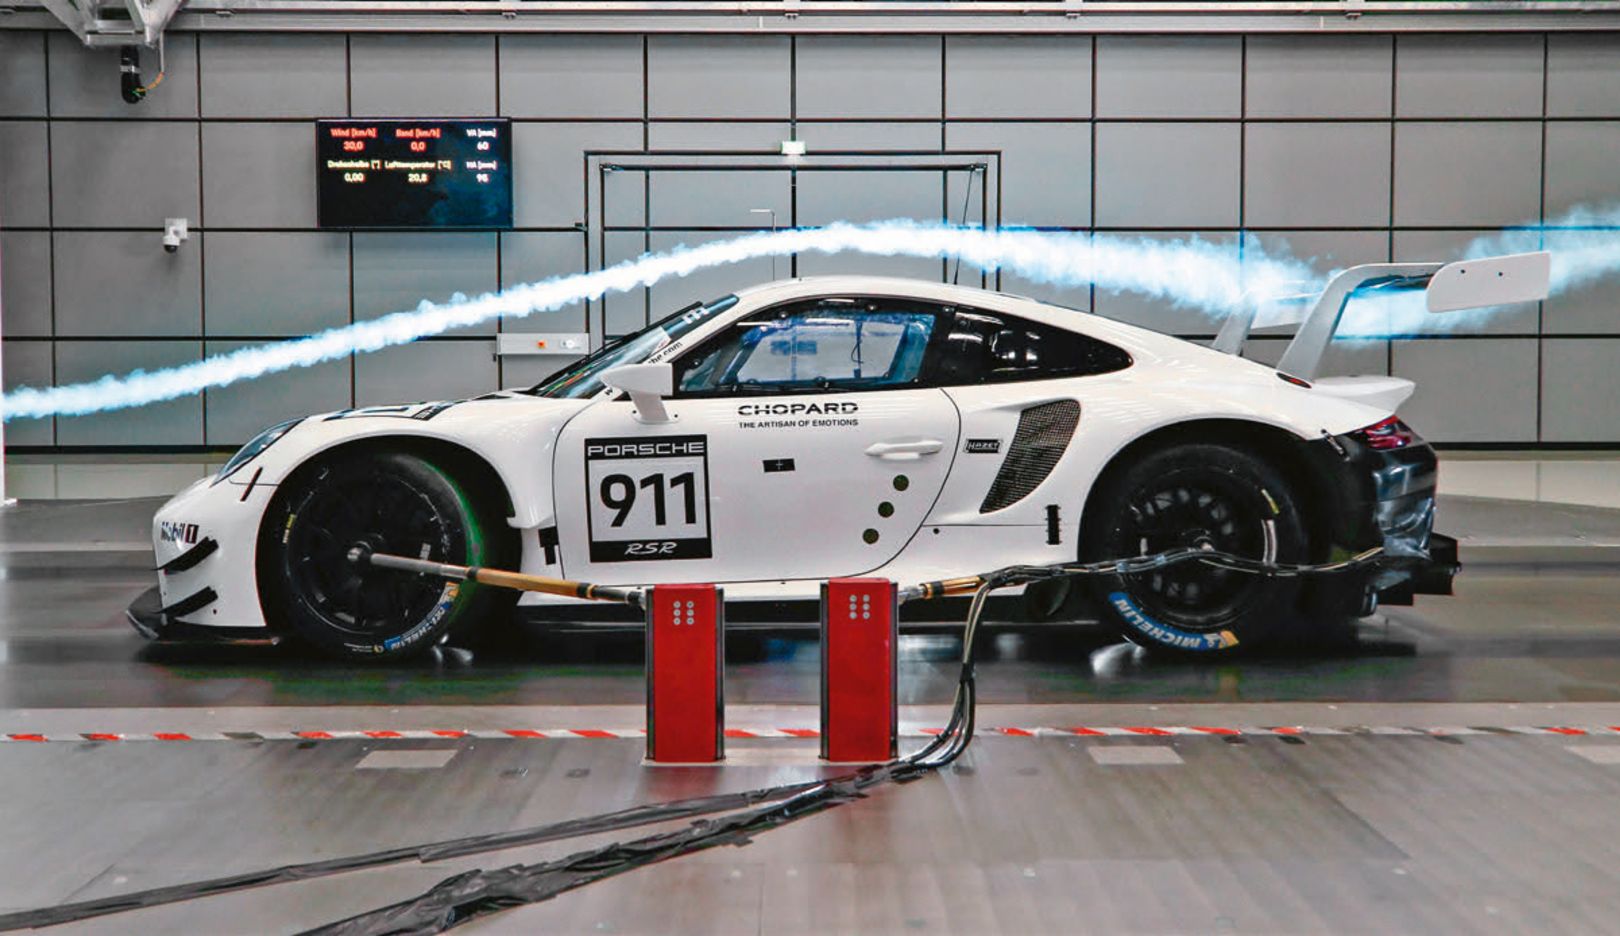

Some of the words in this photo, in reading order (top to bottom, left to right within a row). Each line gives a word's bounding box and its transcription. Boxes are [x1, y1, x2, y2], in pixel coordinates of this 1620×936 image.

[330, 128, 350, 137] Wind
[410, 141, 426, 152] 0,0
[737, 402, 859, 415] CHOPARD
[758, 420, 796, 428] ARTISAN
[812, 419, 859, 427] EMOTIONS
[587, 441, 705, 457] PORSCHE
[600, 471, 697, 528] 911
[624, 541, 678, 555] RSR
[1114, 599, 1201, 649] MICHELIN
